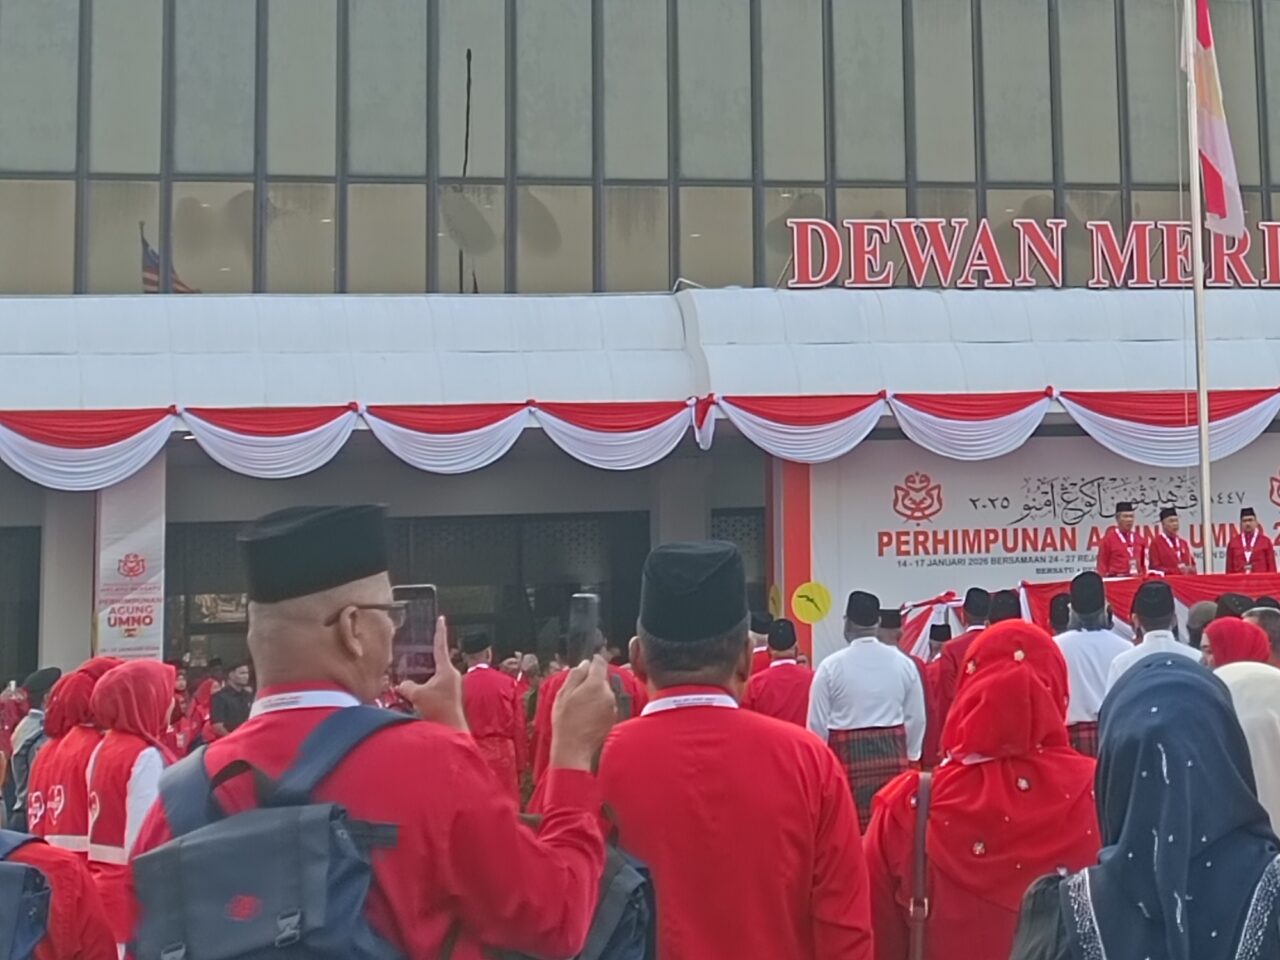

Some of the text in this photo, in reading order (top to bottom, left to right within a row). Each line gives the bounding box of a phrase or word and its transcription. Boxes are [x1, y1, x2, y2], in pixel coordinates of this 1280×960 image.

[787, 218, 1067, 288] DEWAN
[877, 526, 1077, 557] PERHIMPUNAN
[897, 559, 907, 568] 14
[915, 559, 925, 568] 17
[926, 557, 966, 567] JANUARI
[990, 554, 1046, 565] BERSAMAAN
[108, 604, 154, 616] AGUNG
[107, 615, 153, 628] UMNO
